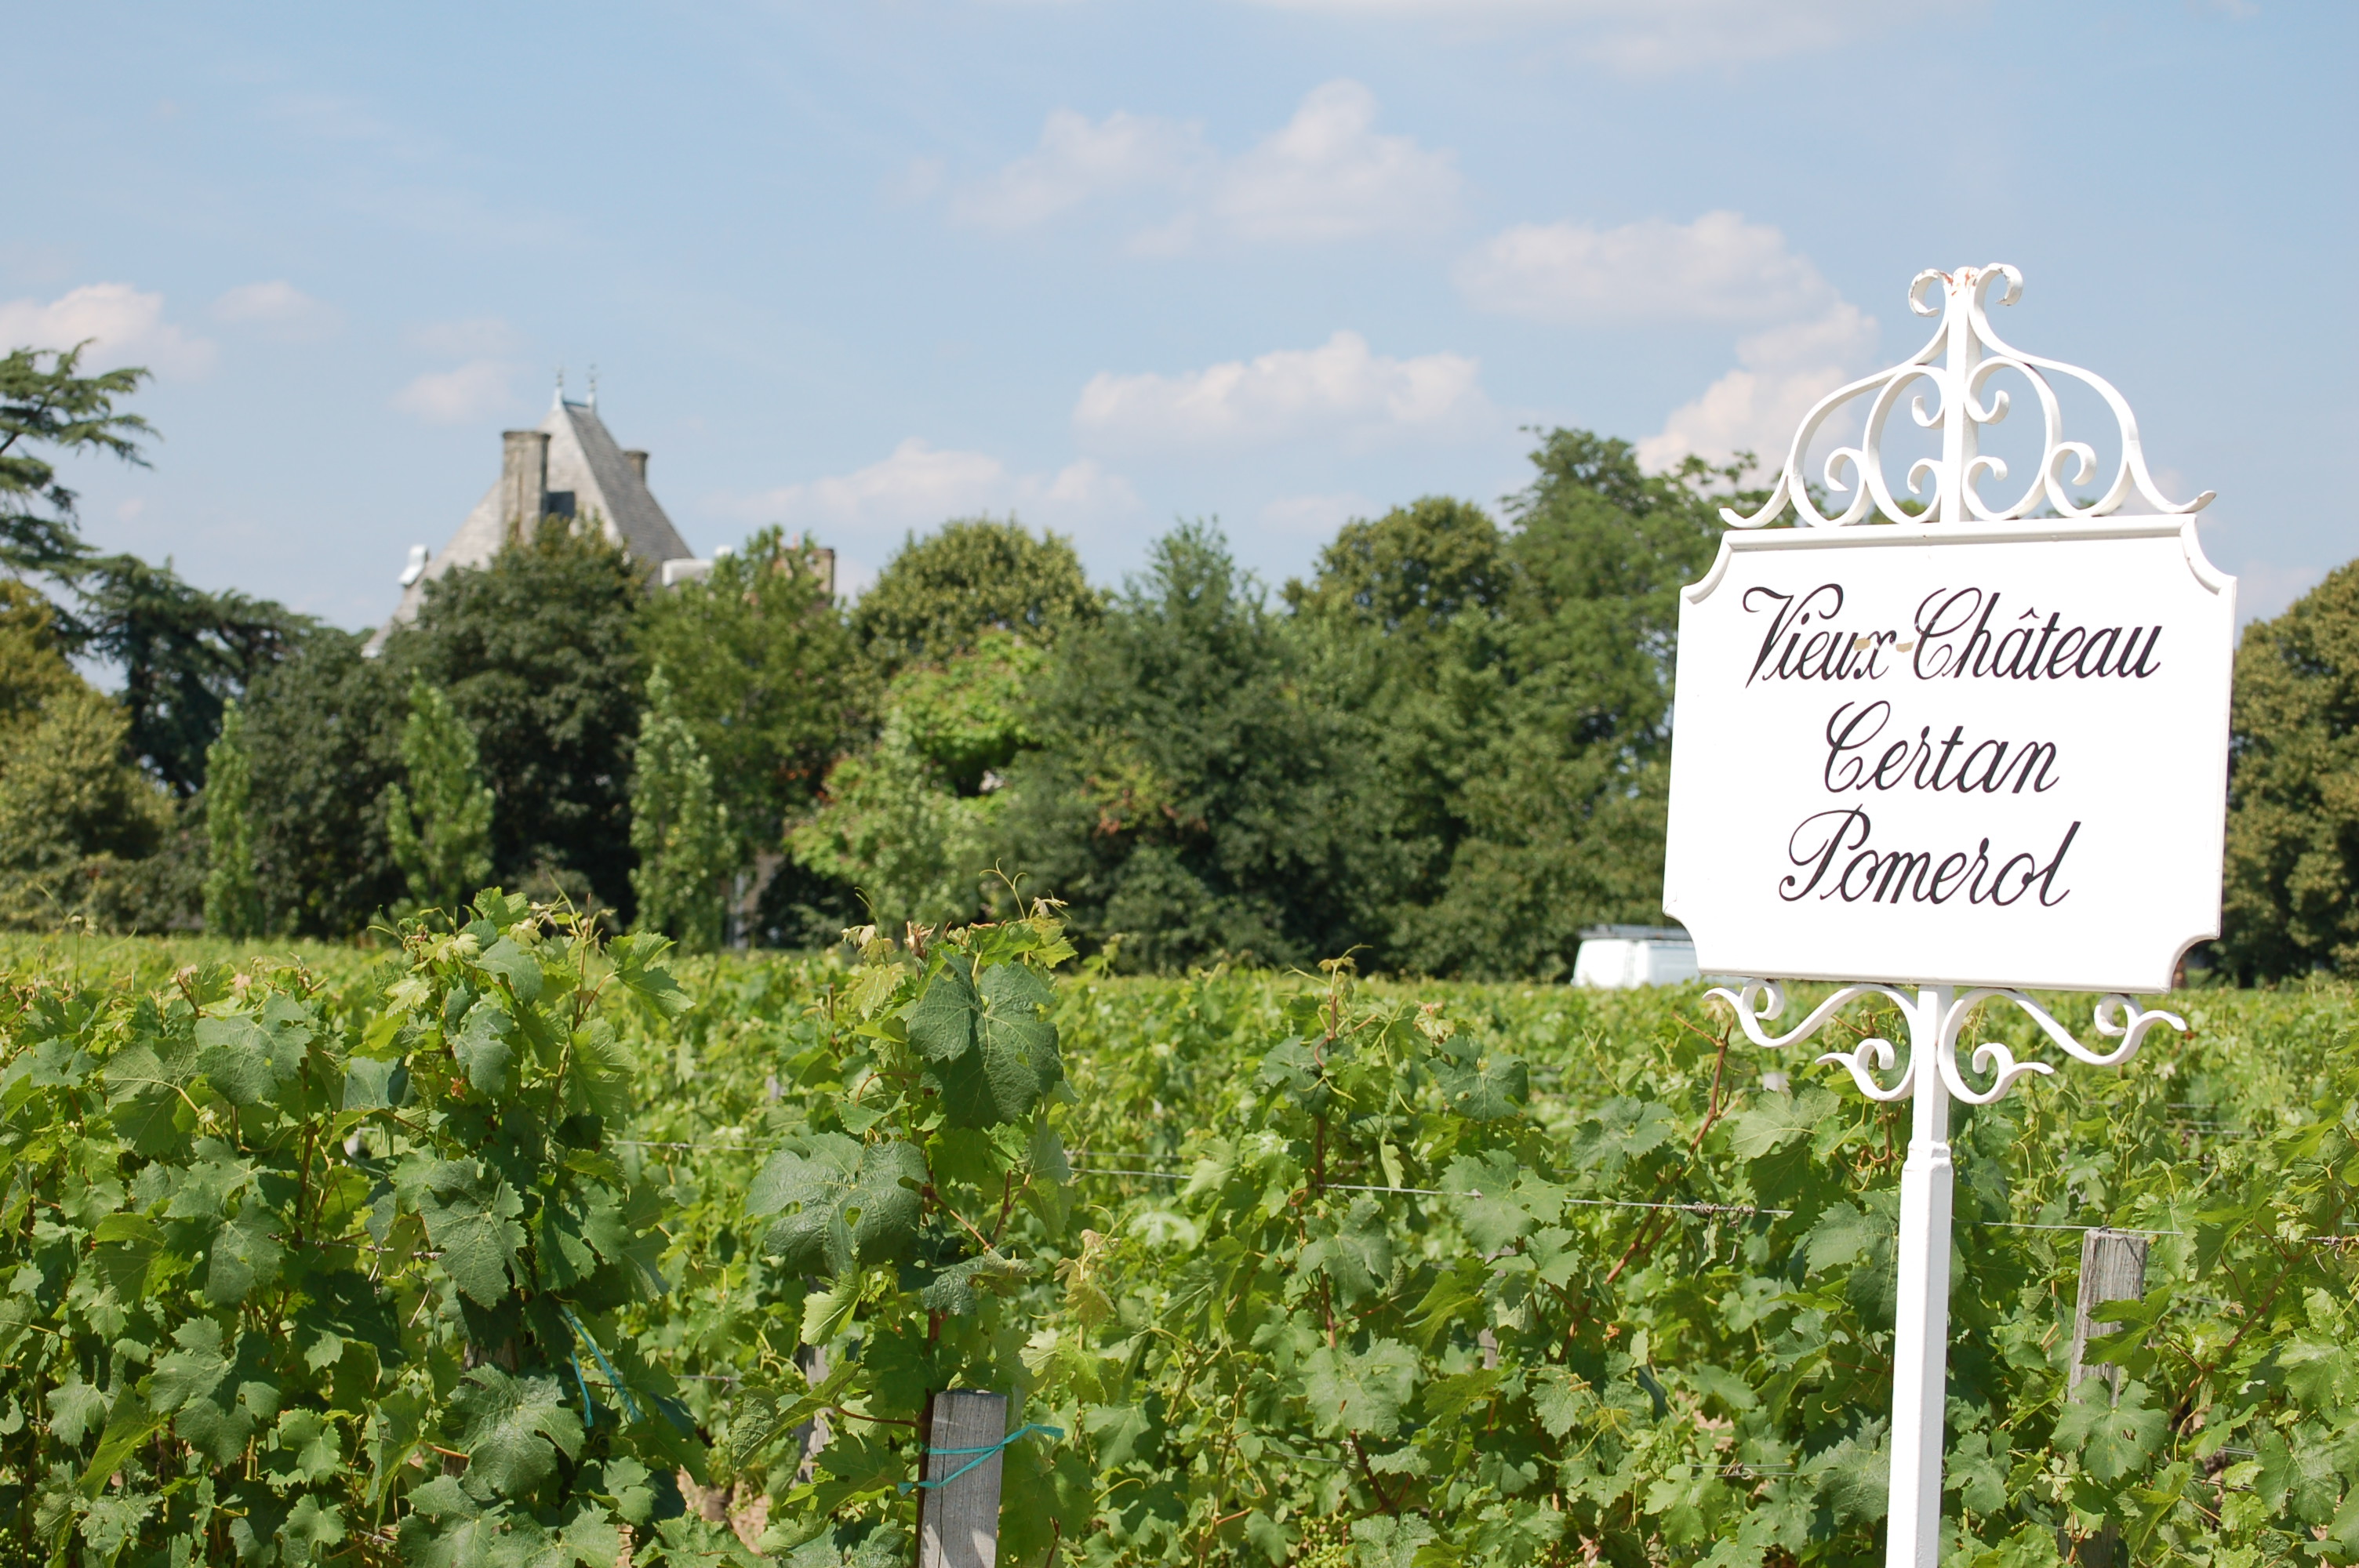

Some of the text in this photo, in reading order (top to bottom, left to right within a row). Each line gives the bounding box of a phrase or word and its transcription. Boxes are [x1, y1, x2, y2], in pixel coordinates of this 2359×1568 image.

[1743, 583, 2162, 688] Vieux Château
[1824, 700, 2059, 793] Certan
[1779, 804, 2081, 907] Pomerol
